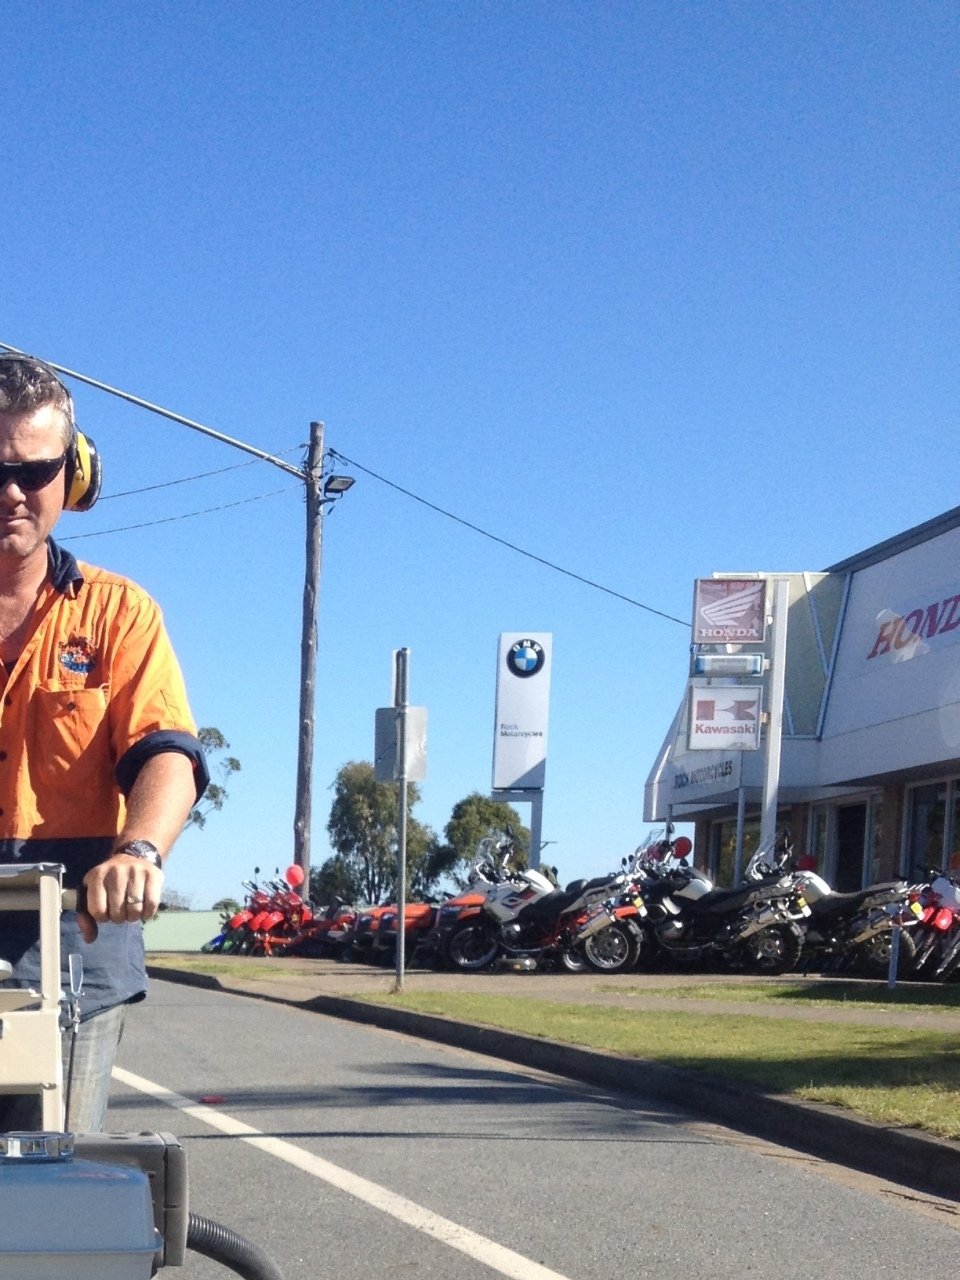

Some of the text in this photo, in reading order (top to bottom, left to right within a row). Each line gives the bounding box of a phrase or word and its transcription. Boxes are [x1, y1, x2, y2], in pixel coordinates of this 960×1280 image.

[700, 628, 759, 637] HONDA
[512, 640, 542, 652] BMW
[695, 723, 756, 734] Kawasaki
